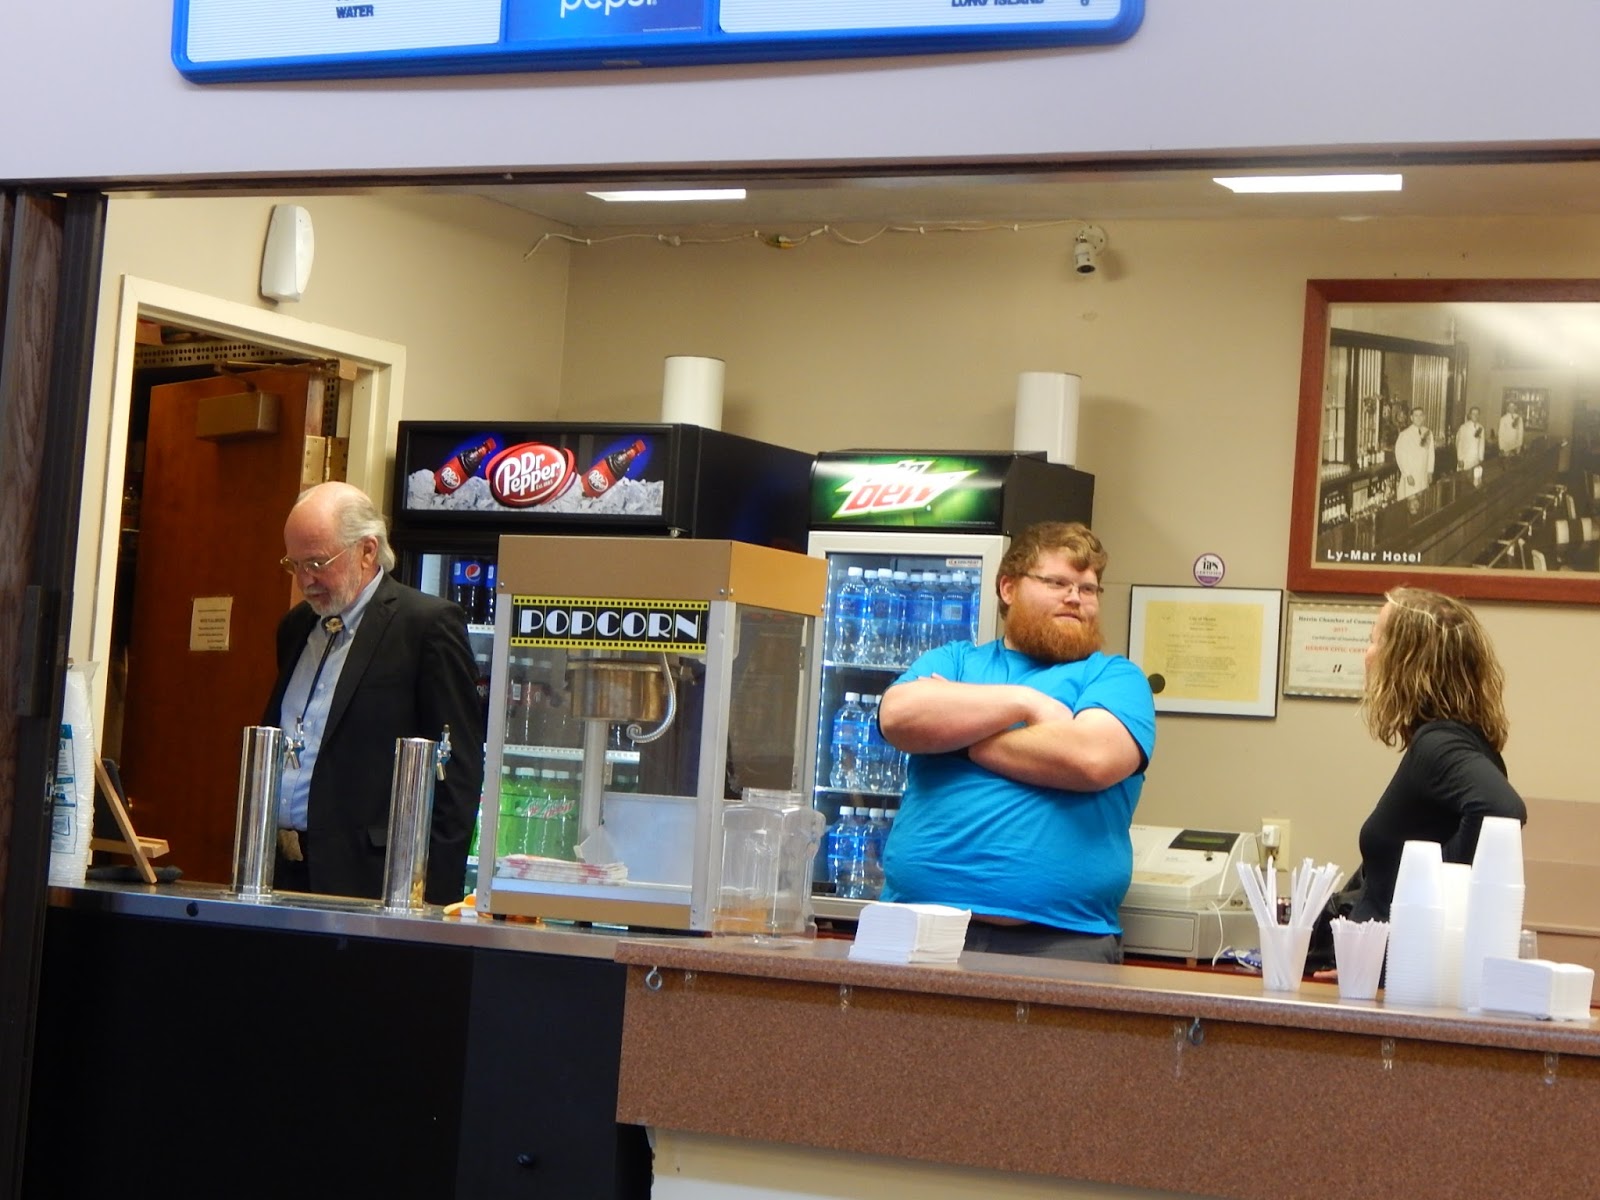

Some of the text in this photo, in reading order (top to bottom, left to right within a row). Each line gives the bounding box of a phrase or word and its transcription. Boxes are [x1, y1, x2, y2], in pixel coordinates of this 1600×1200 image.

[336, 5, 374, 18] WATER
[521, 452, 545, 475] Dr
[500, 457, 561, 497] Pepper
[1327, 549, 1422, 563] Ly-Mar Hotel
[520, 609, 699, 640] POPCORN
